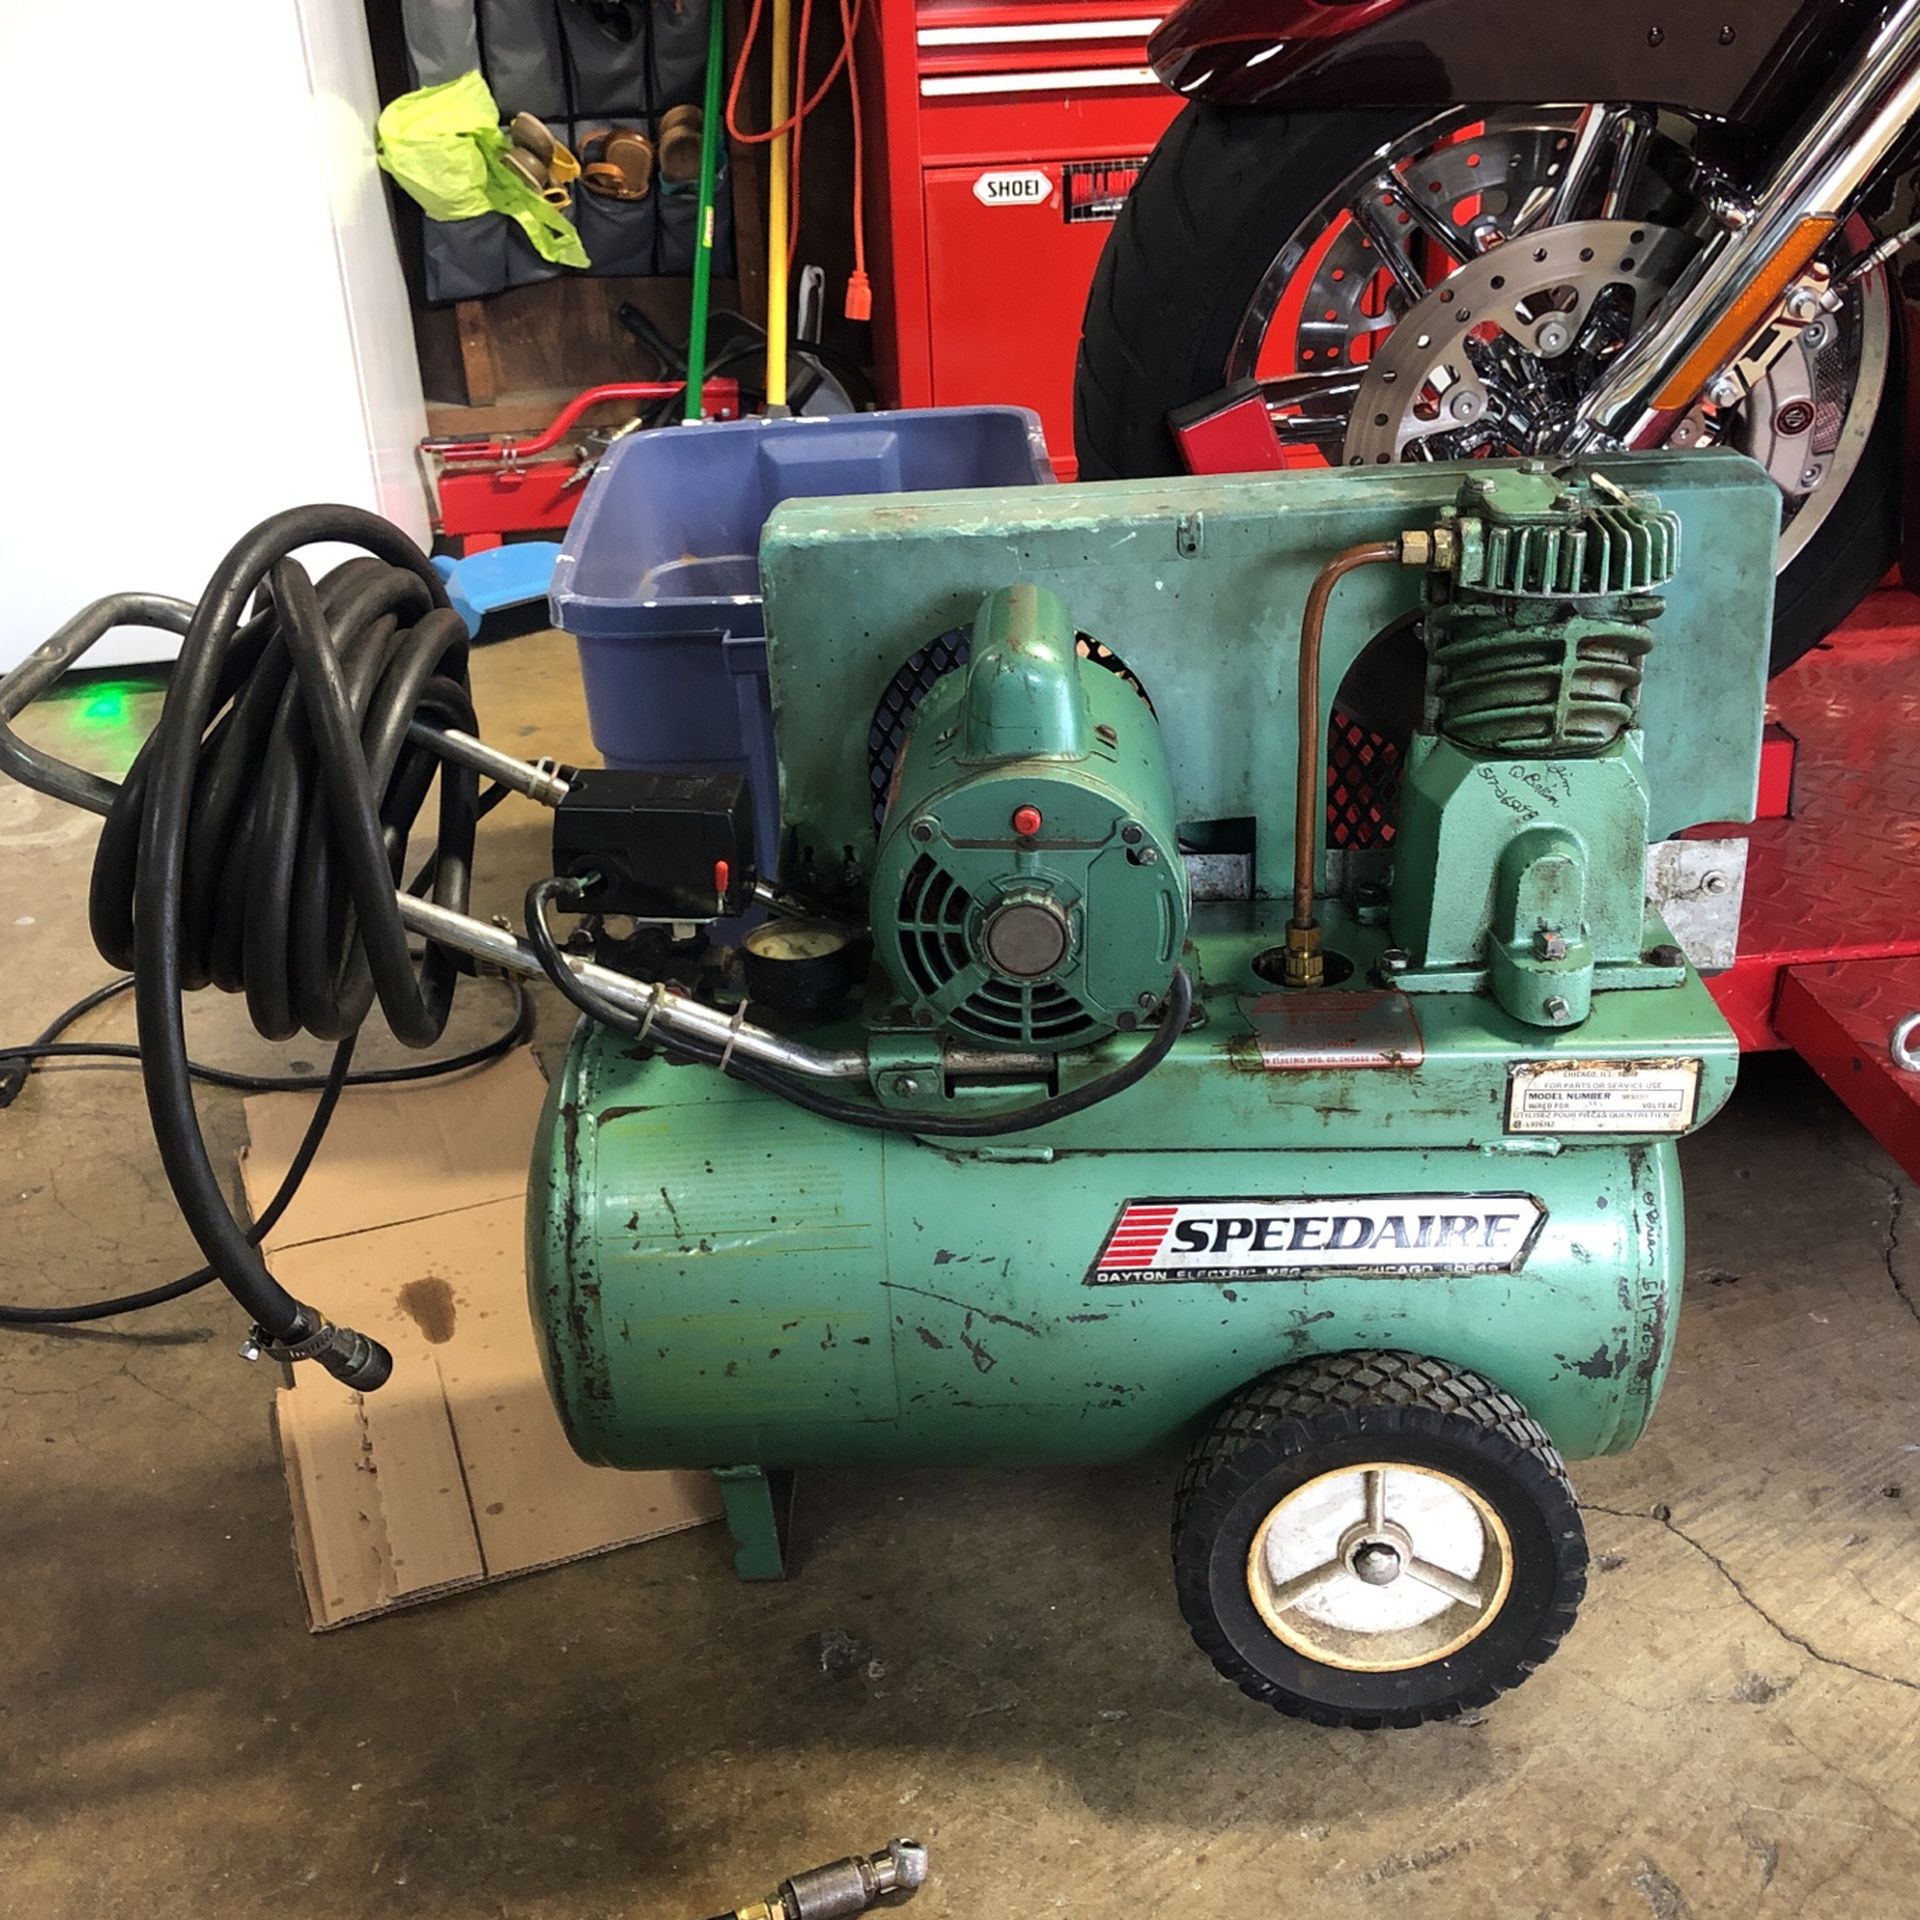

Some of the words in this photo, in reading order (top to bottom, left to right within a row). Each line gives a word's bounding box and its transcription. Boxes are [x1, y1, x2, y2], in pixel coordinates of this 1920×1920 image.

[987, 180, 1039, 198] SHOEI
[1563, 1081, 1592, 1089] PARTS
[1528, 1092, 1563, 1100] MODEL
[1567, 1092, 1611, 1100] NUMBER
[1096, 1271, 1167, 1283] DAYTON
